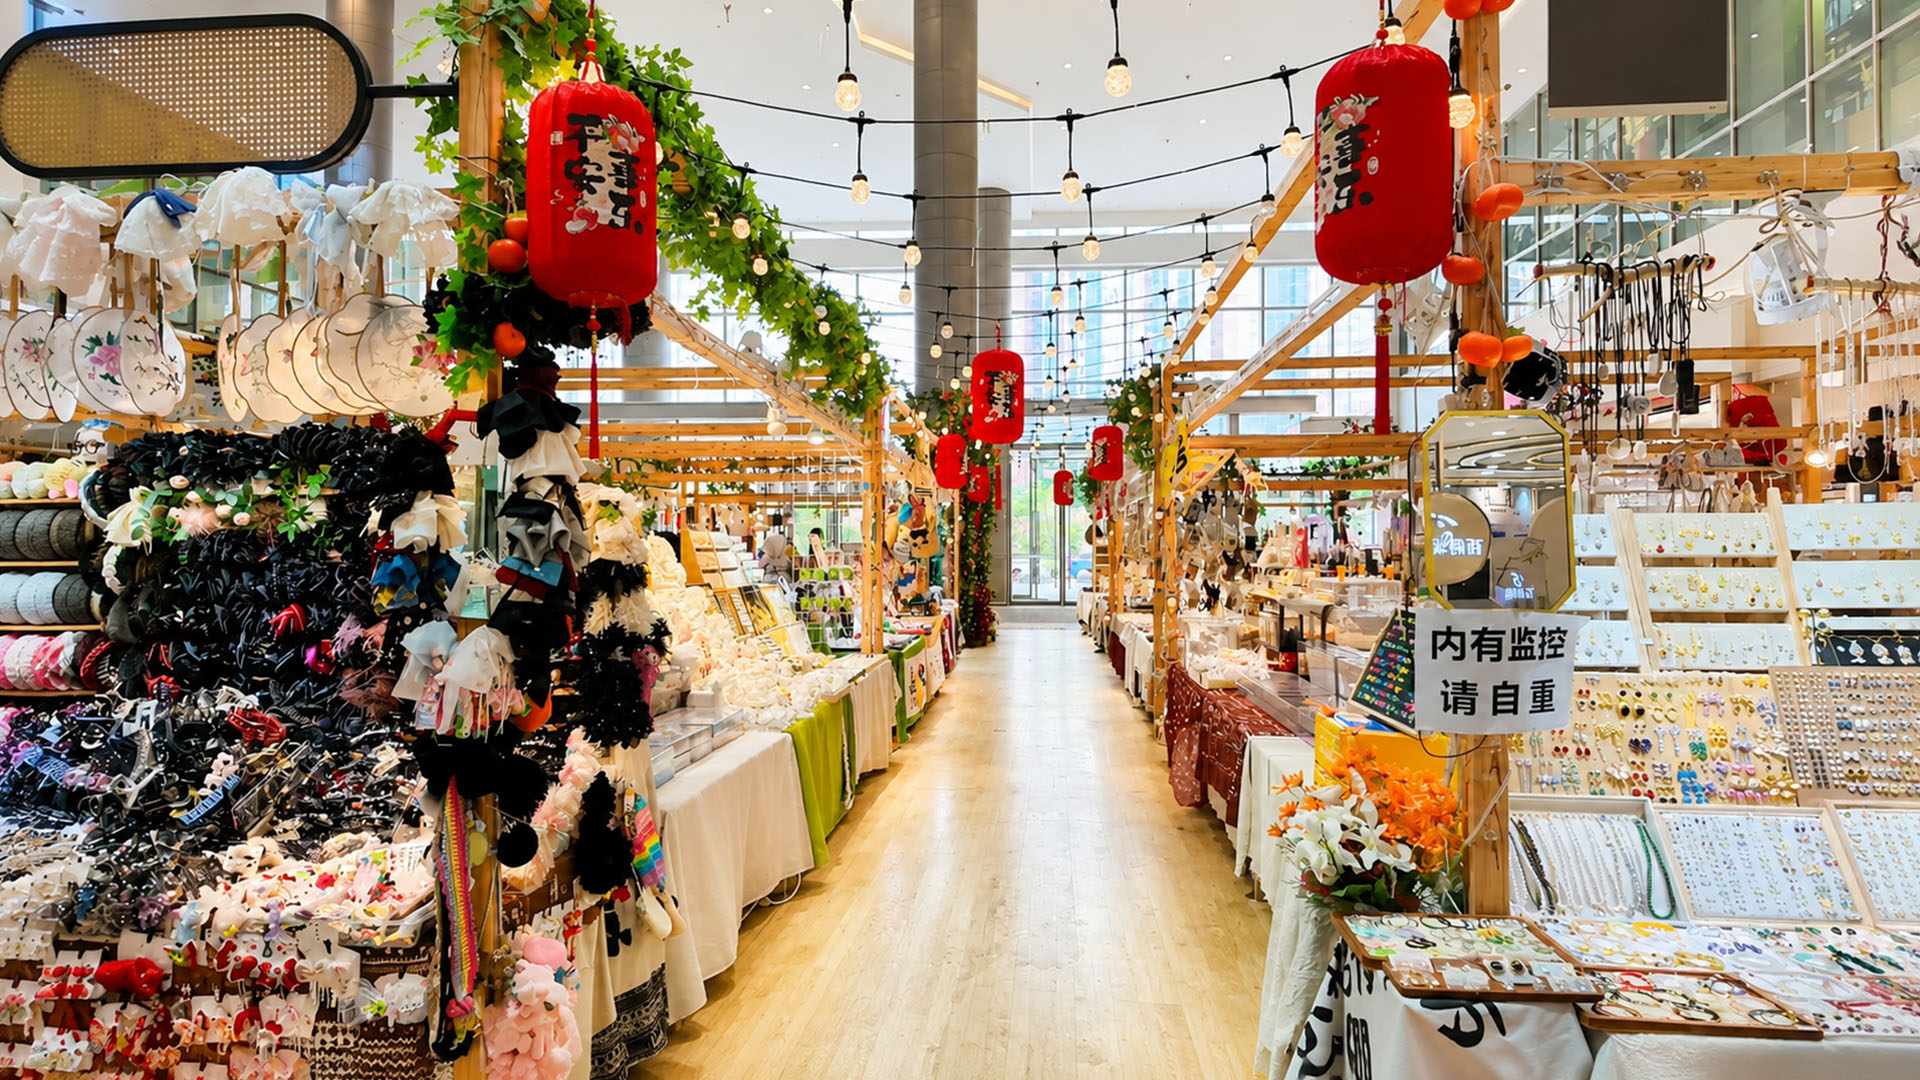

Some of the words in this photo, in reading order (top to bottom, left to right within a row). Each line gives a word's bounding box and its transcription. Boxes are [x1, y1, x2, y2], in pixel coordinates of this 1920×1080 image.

[1431, 625, 1568, 662] 内有监控
[1440, 678, 1556, 716] 请自重
